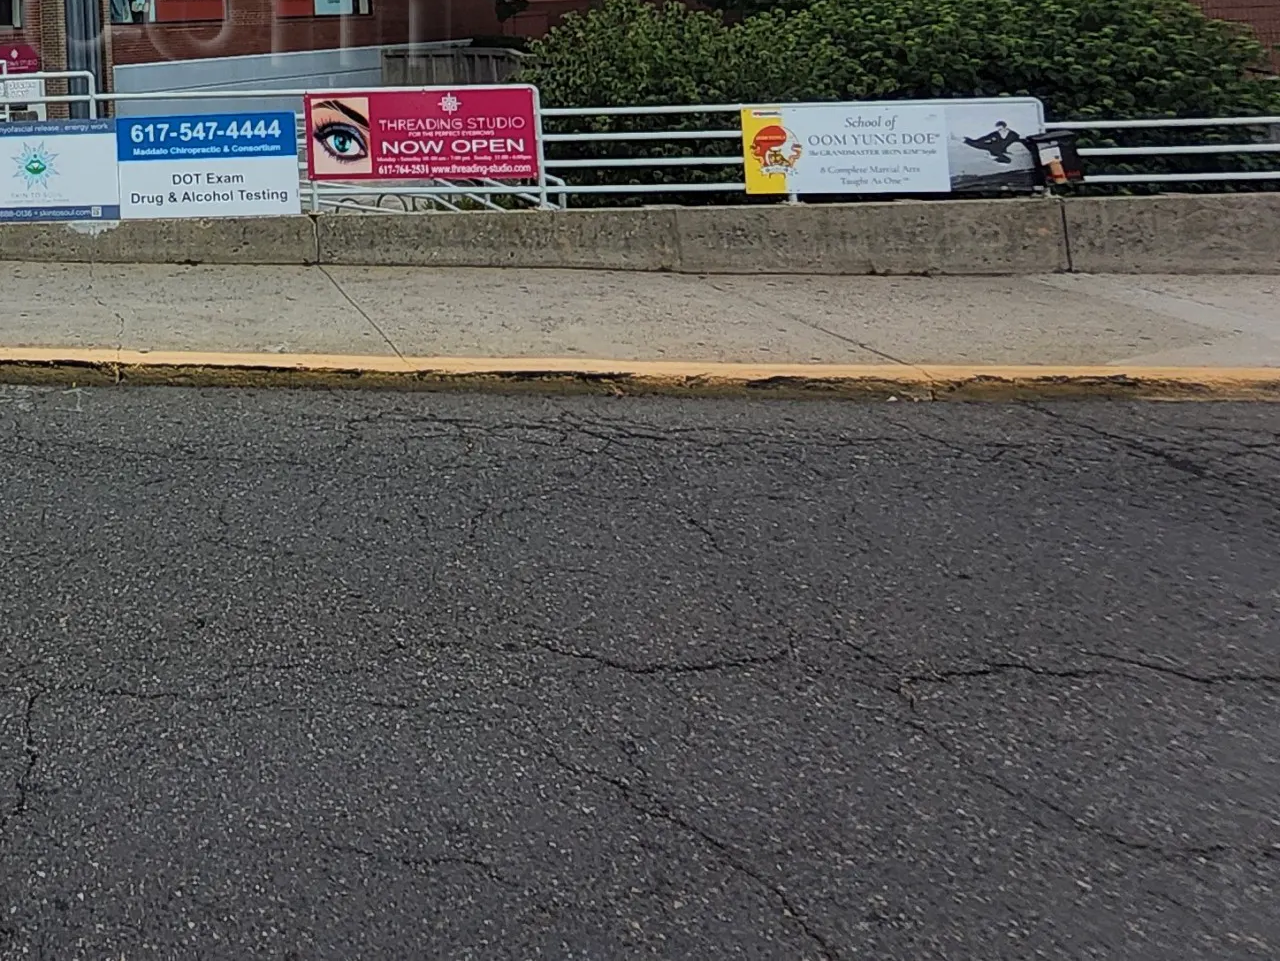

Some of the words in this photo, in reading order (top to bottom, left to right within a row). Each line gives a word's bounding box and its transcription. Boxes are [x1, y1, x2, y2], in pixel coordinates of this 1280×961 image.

[34, 124, 60, 132] release
[64, 124, 89, 133] energy
[378, 118, 463, 131] THREADING
[467, 116, 525, 129] STUDIO
[844, 116, 882, 128] School
[884, 115, 898, 131] of
[130, 119, 282, 143] 617-547-4444
[808, 134, 847, 146] OOM
[851, 134, 898, 146] YUNG
[132, 147, 168, 156] Maddalo
[170, 145, 221, 155] Chiropractic
[223, 145, 230, 153] &
[232, 144, 281, 152] Consortium
[382, 140, 444, 155] NOW
[451, 139, 524, 154] OPEN
[378, 164, 429, 175] 617-764-2531
[431, 163, 532, 175] www.threading-studio.com
[827, 165, 868, 176] Complete
[869, 164, 900, 174] Martial
[902, 165, 920, 173] Arts
[172, 174, 202, 185] DOT
[206, 173, 244, 184] Exam
[840, 177, 869, 187] Taught
[871, 177, 882, 185] As
[131, 193, 164, 206] Drug
[168, 192, 177, 203] &
[181, 190, 234, 203] Alcohol
[238, 189, 288, 202] Testing
[39, 209, 92, 217] skintosoul.com
